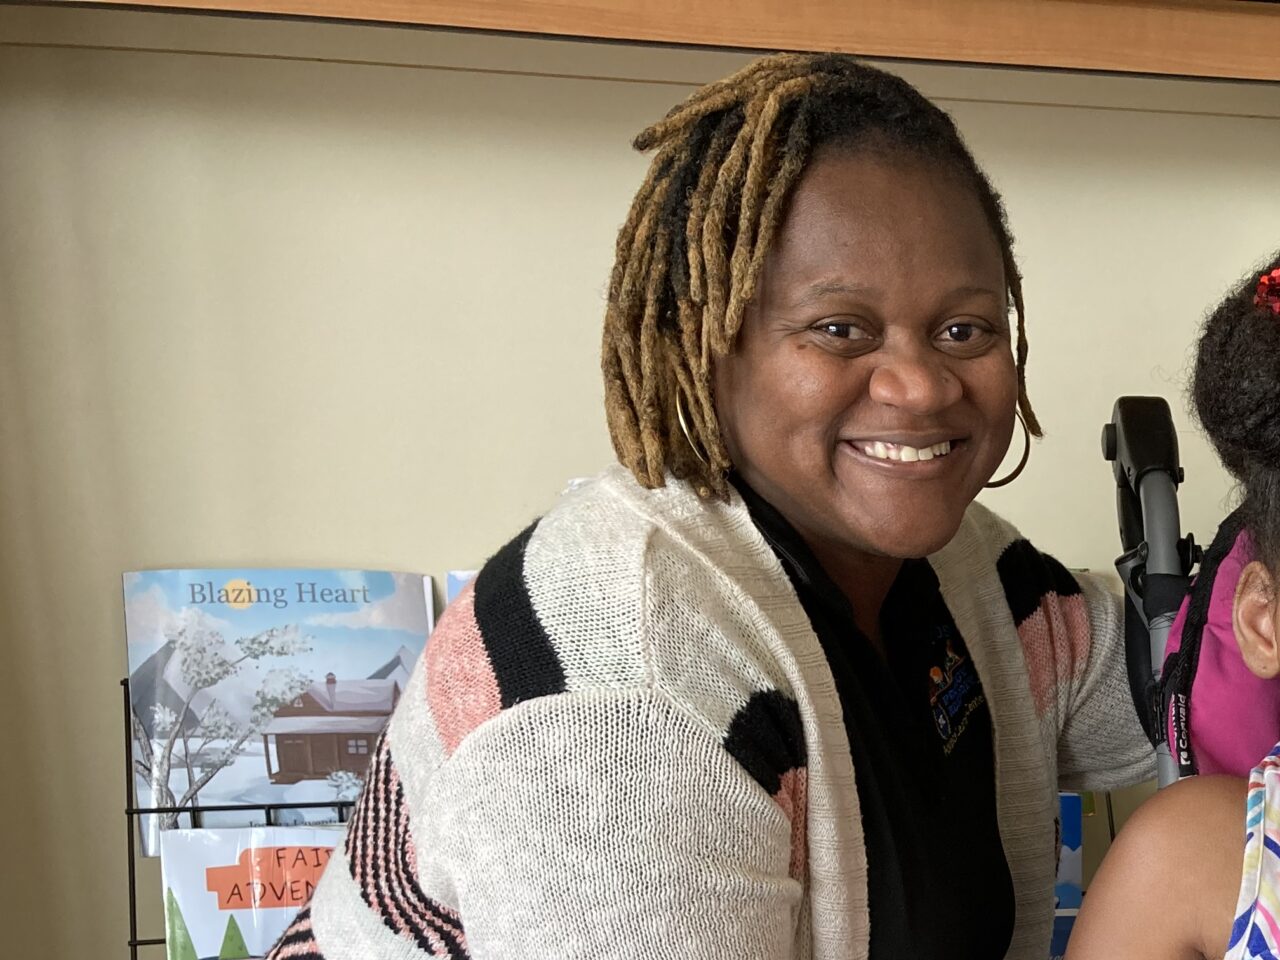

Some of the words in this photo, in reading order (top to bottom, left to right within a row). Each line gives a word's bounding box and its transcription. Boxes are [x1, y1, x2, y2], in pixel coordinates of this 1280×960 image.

[188, 581, 288, 609] Blazing
[295, 582, 371, 604] Heart
[275, 847, 335, 869] FAI
[226, 880, 317, 904] ADVEN
